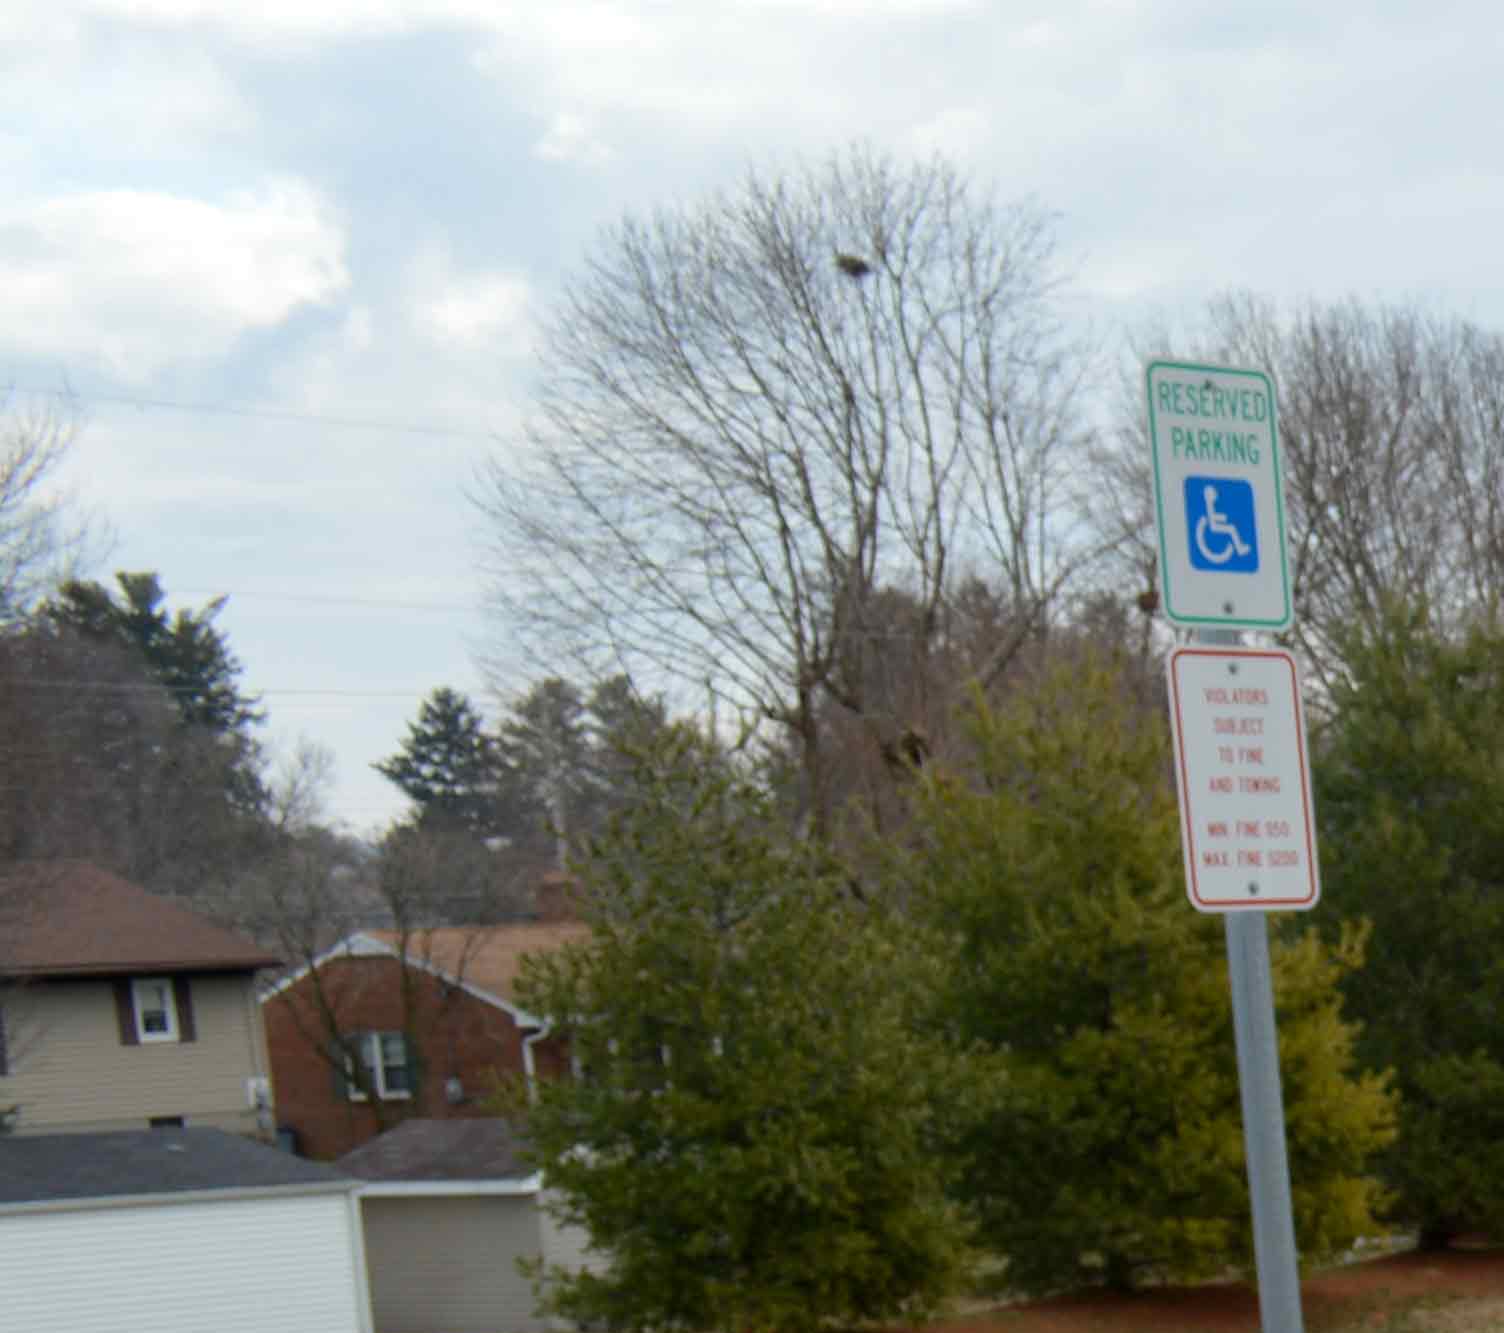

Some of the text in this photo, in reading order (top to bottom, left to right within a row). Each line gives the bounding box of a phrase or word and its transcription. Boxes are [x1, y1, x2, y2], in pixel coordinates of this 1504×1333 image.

[1157, 381, 1266, 422] RESERVED
[1171, 426, 1260, 465] PARKING
[1203, 687, 1269, 705] VIOLATORS
[1213, 716, 1265, 736] SUBJECT
[1217, 745, 1265, 766] TO FINE
[1208, 776, 1281, 794] AND TOWING
[1236, 820, 1261, 838] FINE
[1237, 850, 1263, 868] FINE
